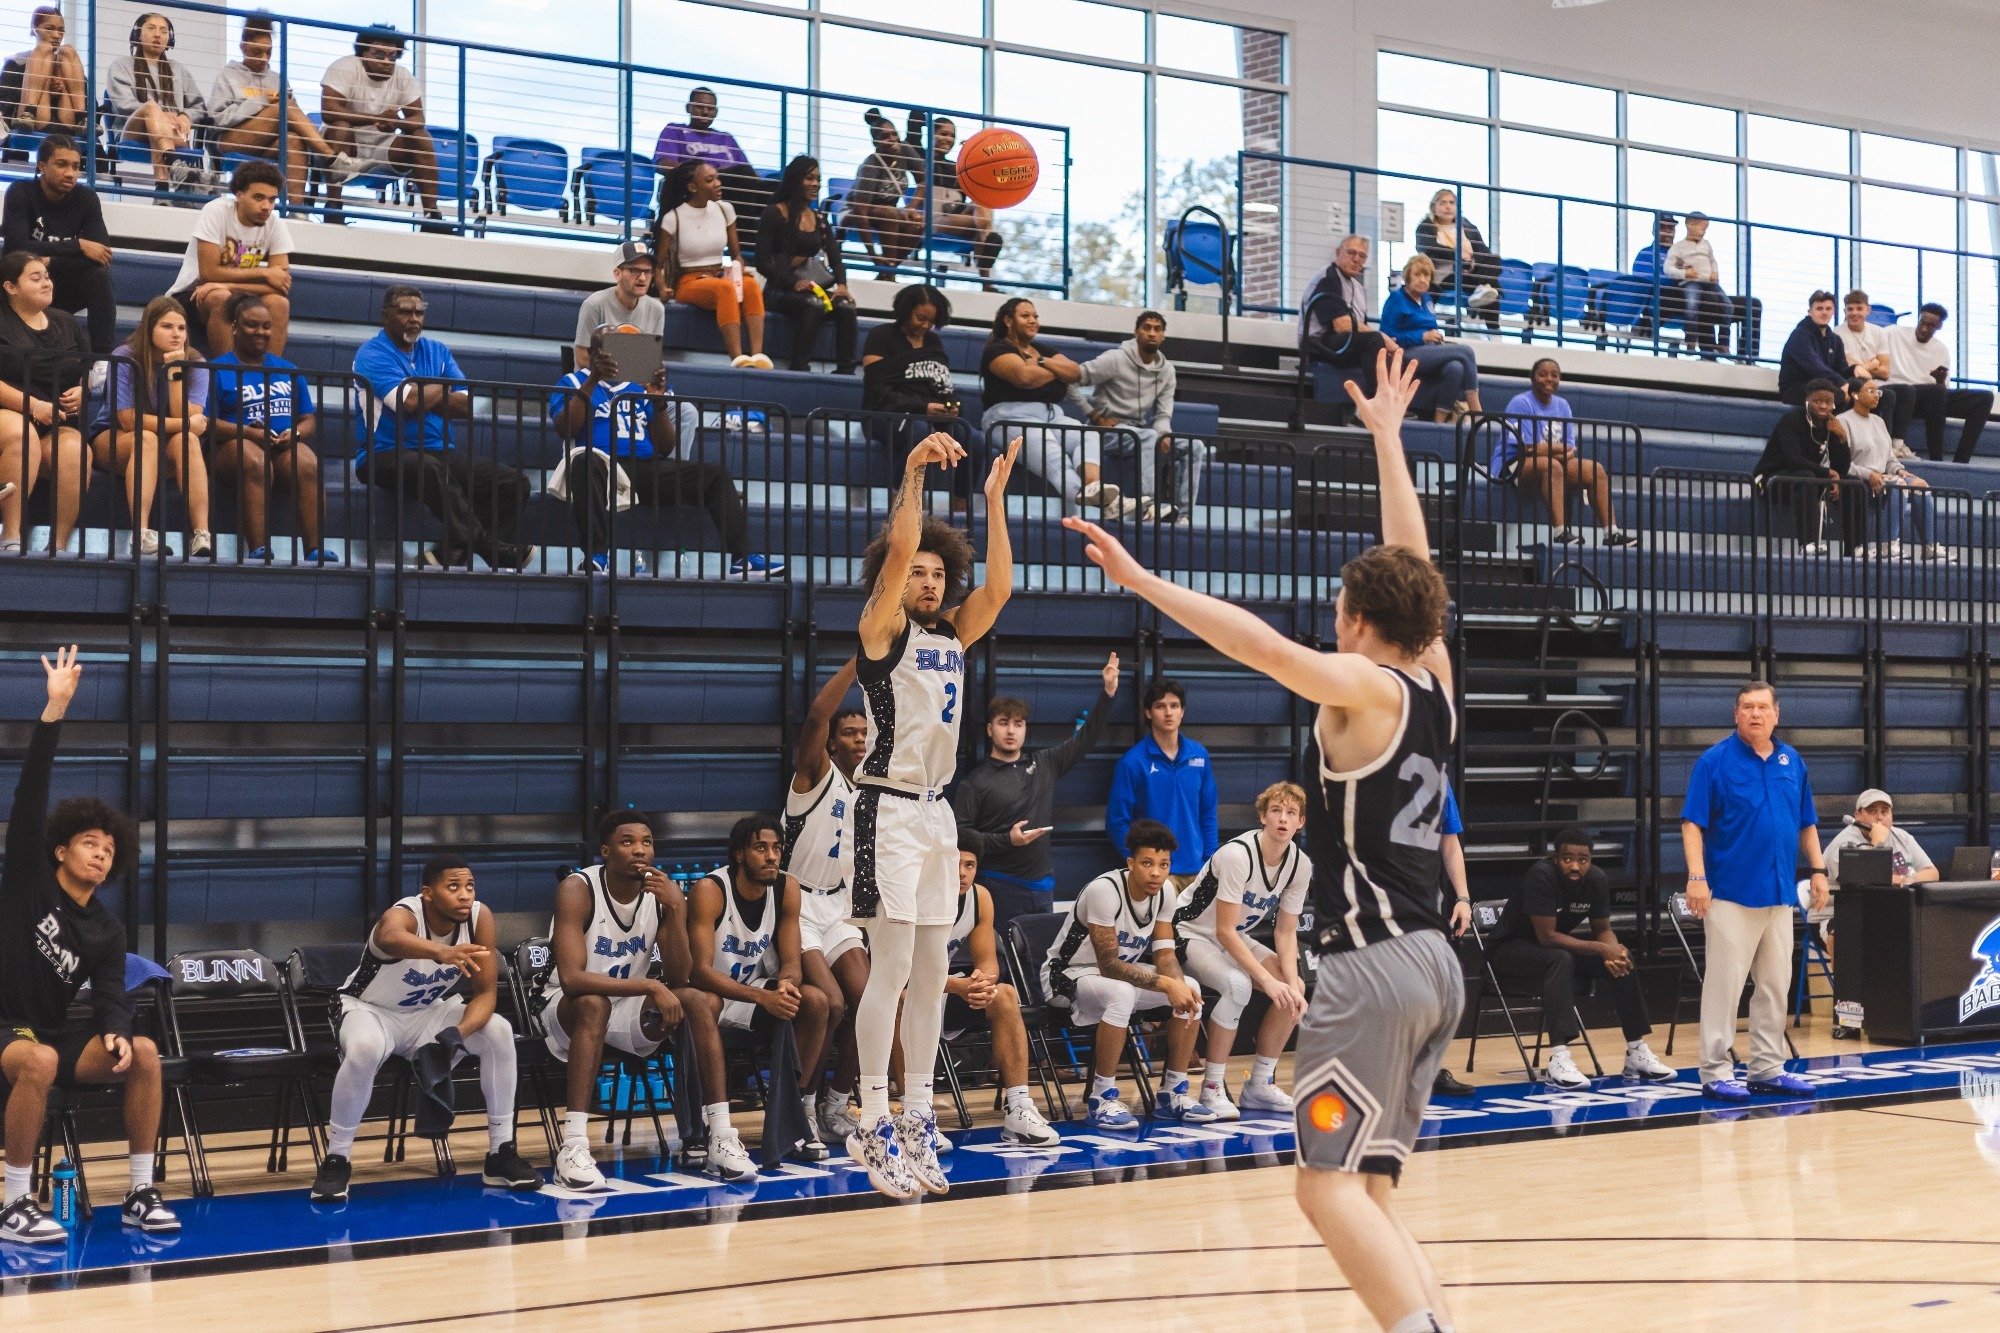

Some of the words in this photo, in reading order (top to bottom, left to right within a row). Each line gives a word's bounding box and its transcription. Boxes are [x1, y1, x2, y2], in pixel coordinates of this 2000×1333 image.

[992, 164, 1035, 177] LEGACY
[942, 682, 957, 723] 2
[181, 958, 263, 984] BLINN
[1329, 1112, 1343, 1129] S
